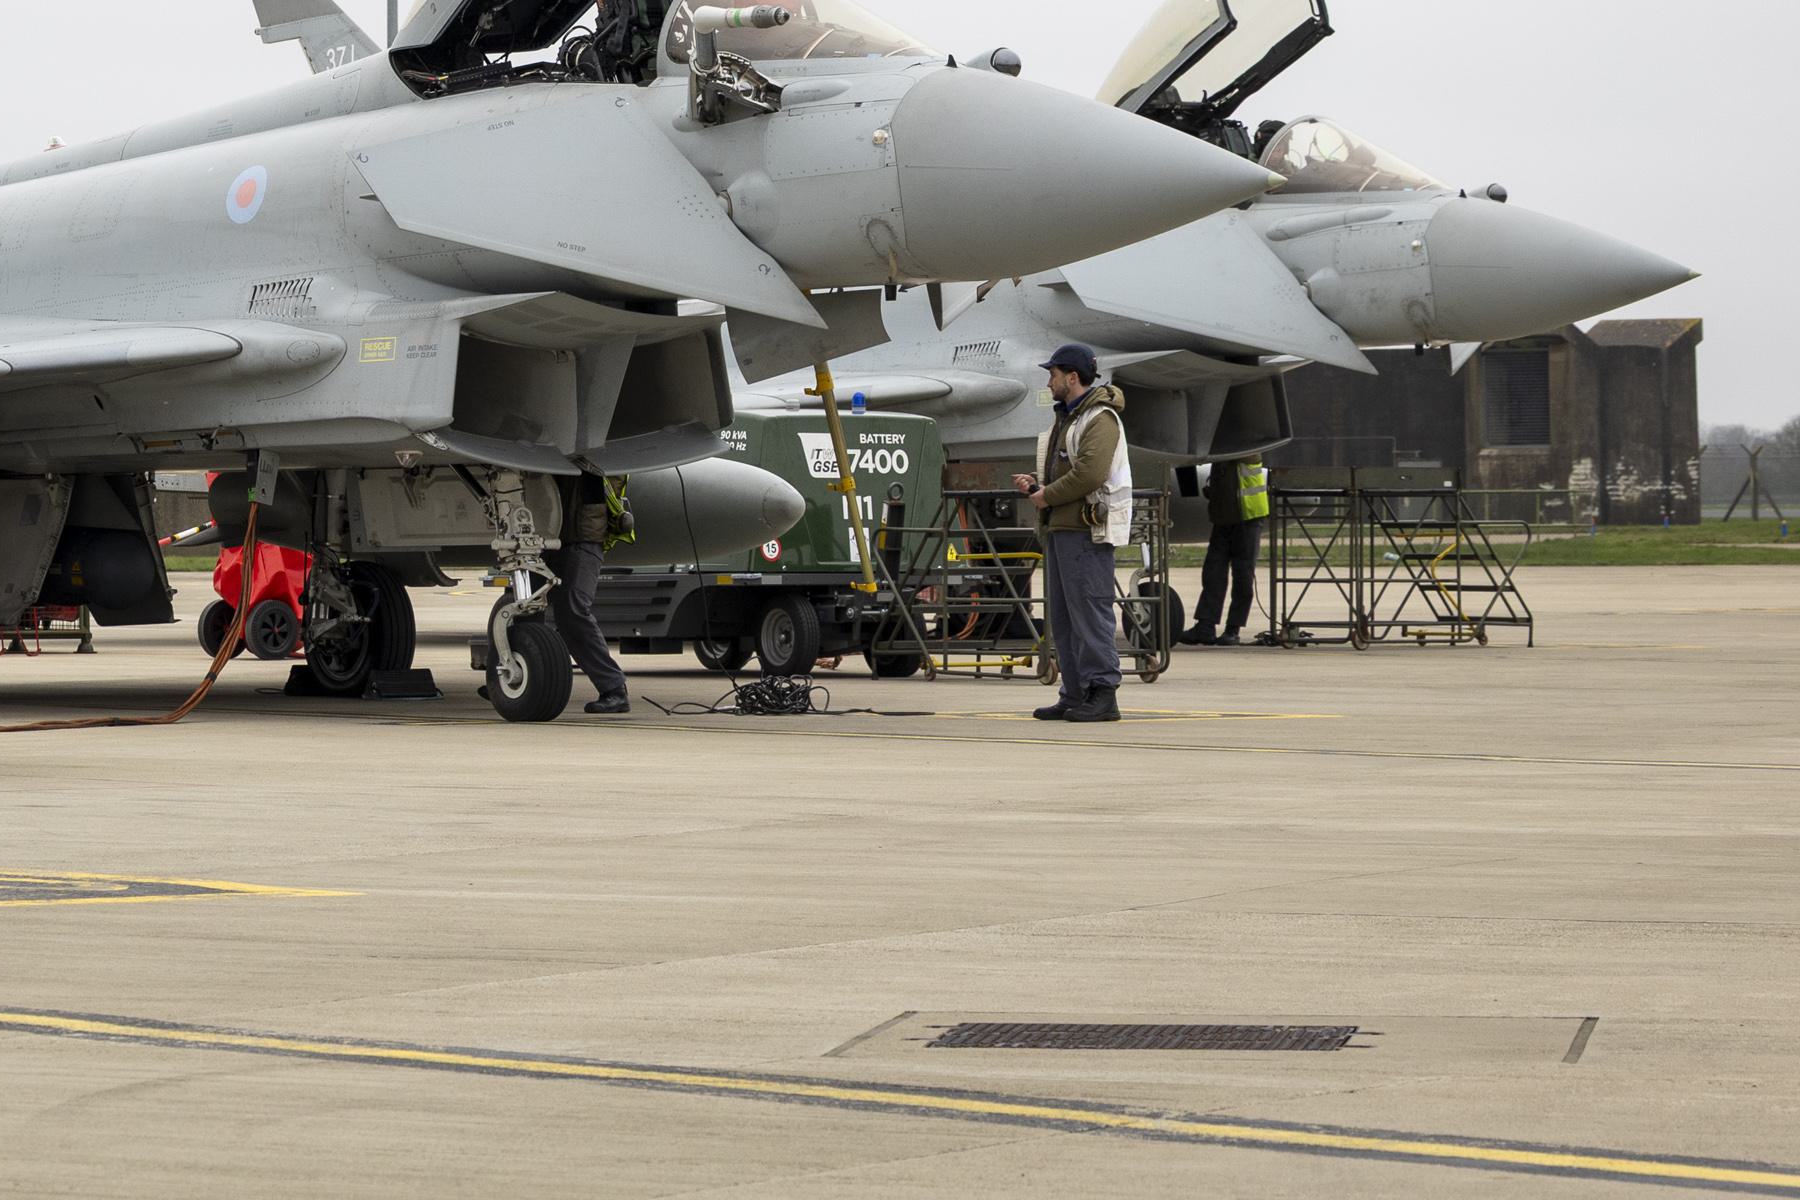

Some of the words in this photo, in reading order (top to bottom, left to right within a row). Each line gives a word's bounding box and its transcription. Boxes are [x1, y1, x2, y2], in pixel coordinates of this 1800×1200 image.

[720, 430, 731, 440] 90
[732, 430, 747, 440] kVA
[859, 433, 906, 445] BATTERY
[736, 441, 747, 451] Hz
[810, 448, 836, 460] ITW
[813, 460, 840, 473] GSE
[847, 449, 910, 475] 7400
[766, 543, 776, 554] 15
